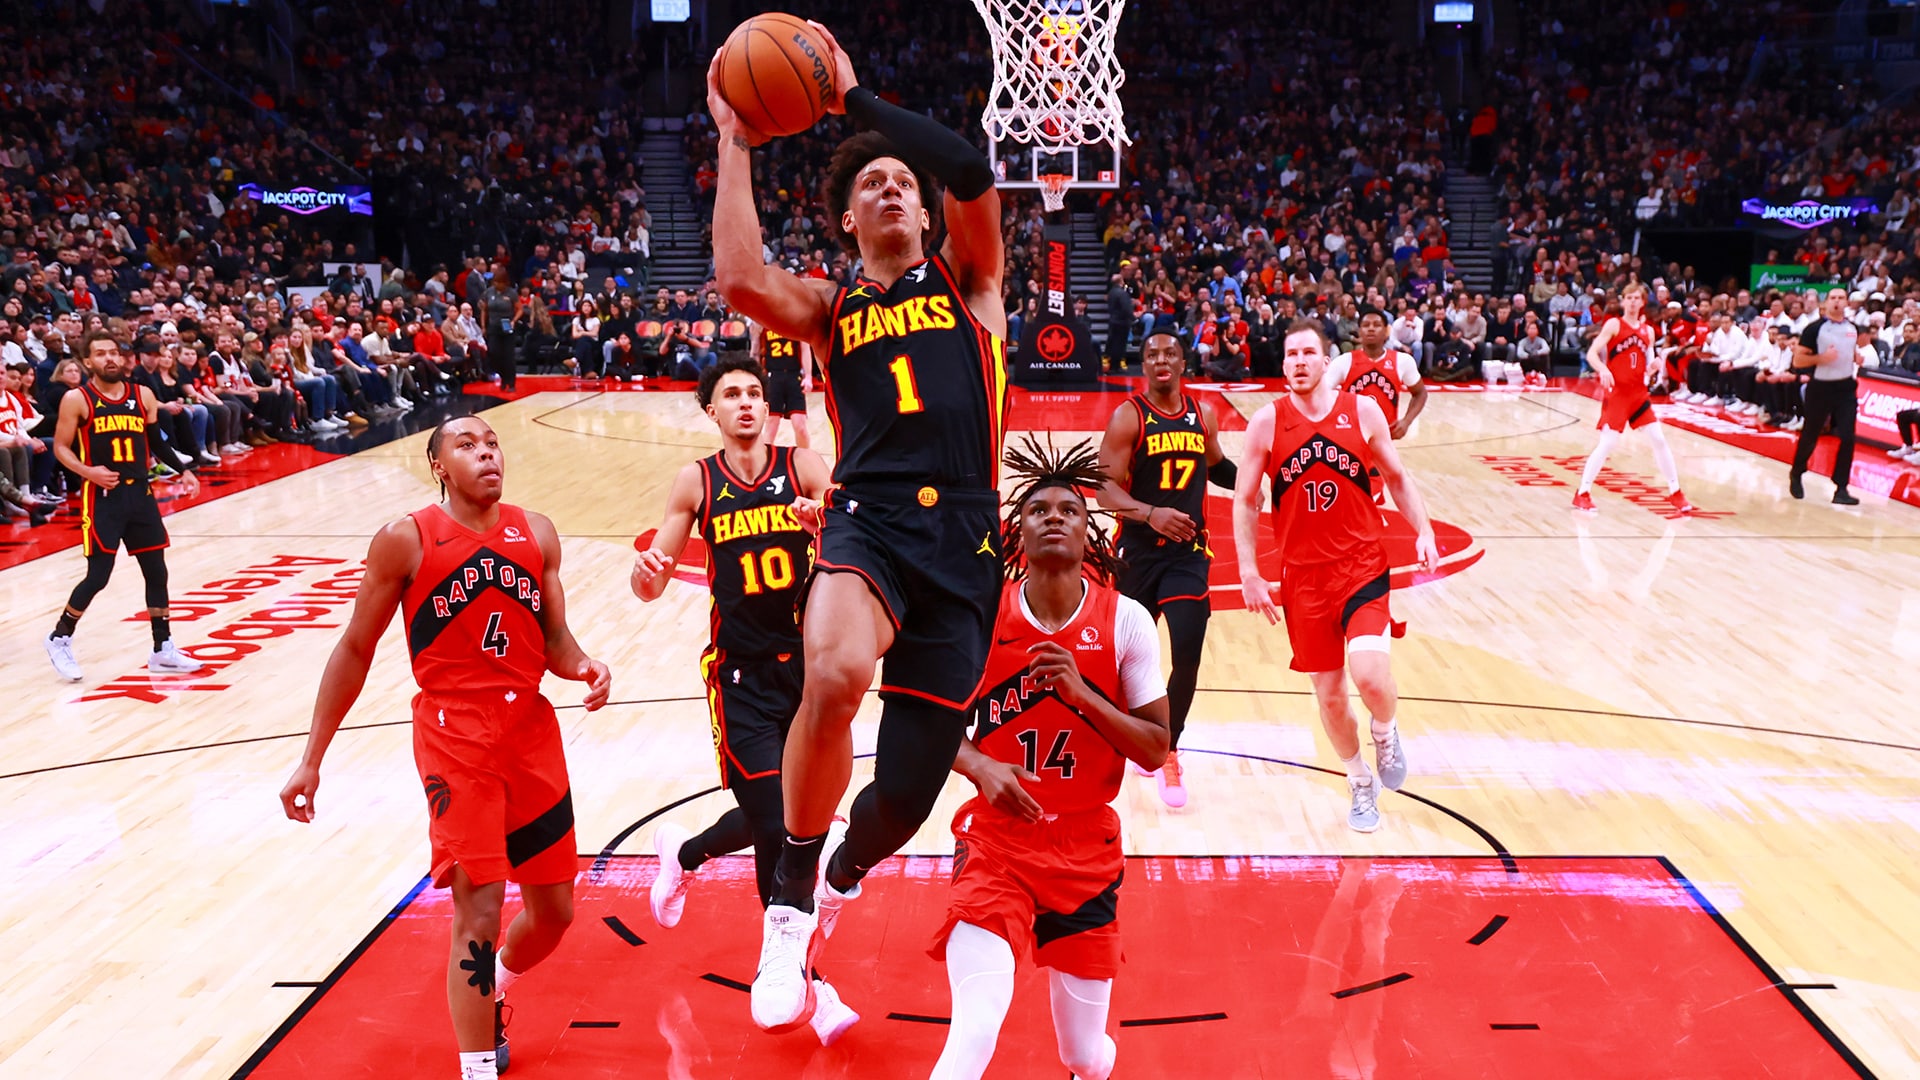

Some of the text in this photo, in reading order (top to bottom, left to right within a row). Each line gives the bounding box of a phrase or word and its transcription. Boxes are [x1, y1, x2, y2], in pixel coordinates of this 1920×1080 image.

[262, 190, 346, 205] JACKPOT CITY
[1761, 204, 1852, 219] JACKPOT CITY
[1048, 240, 1067, 317] POINTSBET
[838, 294, 957, 356] HAWKS
[770, 341, 794, 357] 24
[1630, 351, 1638, 369] 1
[888, 353, 926, 415] 1
[93, 414, 145, 434] HAWKS
[111, 437, 136, 463] 11
[1146, 431, 1205, 457] HAWKS
[1159, 458, 1198, 491] 17
[1281, 441, 1360, 482] RAPTORS
[1302, 479, 1339, 513] 19
[711, 504, 804, 546] HAWKS
[738, 545, 797, 596] 10
[433, 558, 541, 618] RAPTORS
[481, 611, 510, 658] 4
[1075, 643, 1103, 651] Sun Life
[1015, 728, 1077, 779] 14
